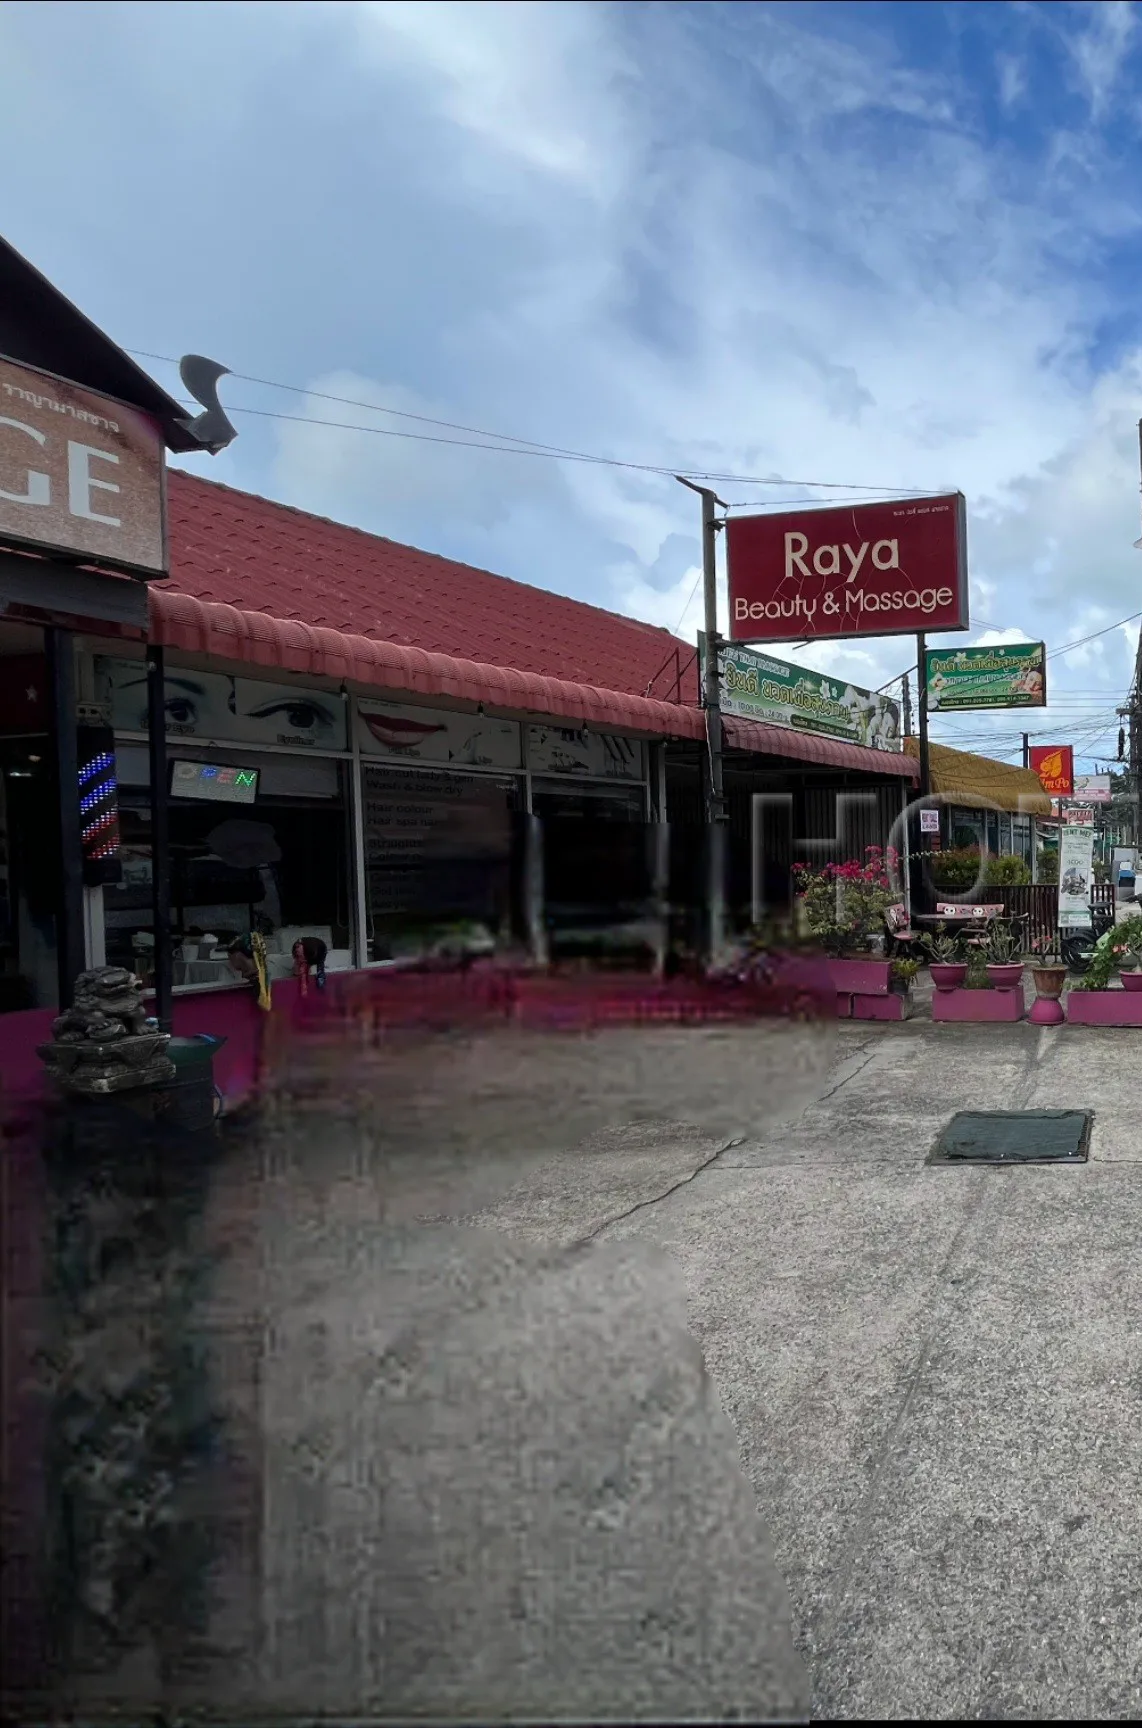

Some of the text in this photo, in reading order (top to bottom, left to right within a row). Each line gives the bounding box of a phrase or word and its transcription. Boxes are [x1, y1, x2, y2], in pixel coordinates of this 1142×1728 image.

[785, 531, 899, 583] Raya
[735, 585, 954, 622] Beauty & Massage
[178, 765, 257, 787] OPEN
